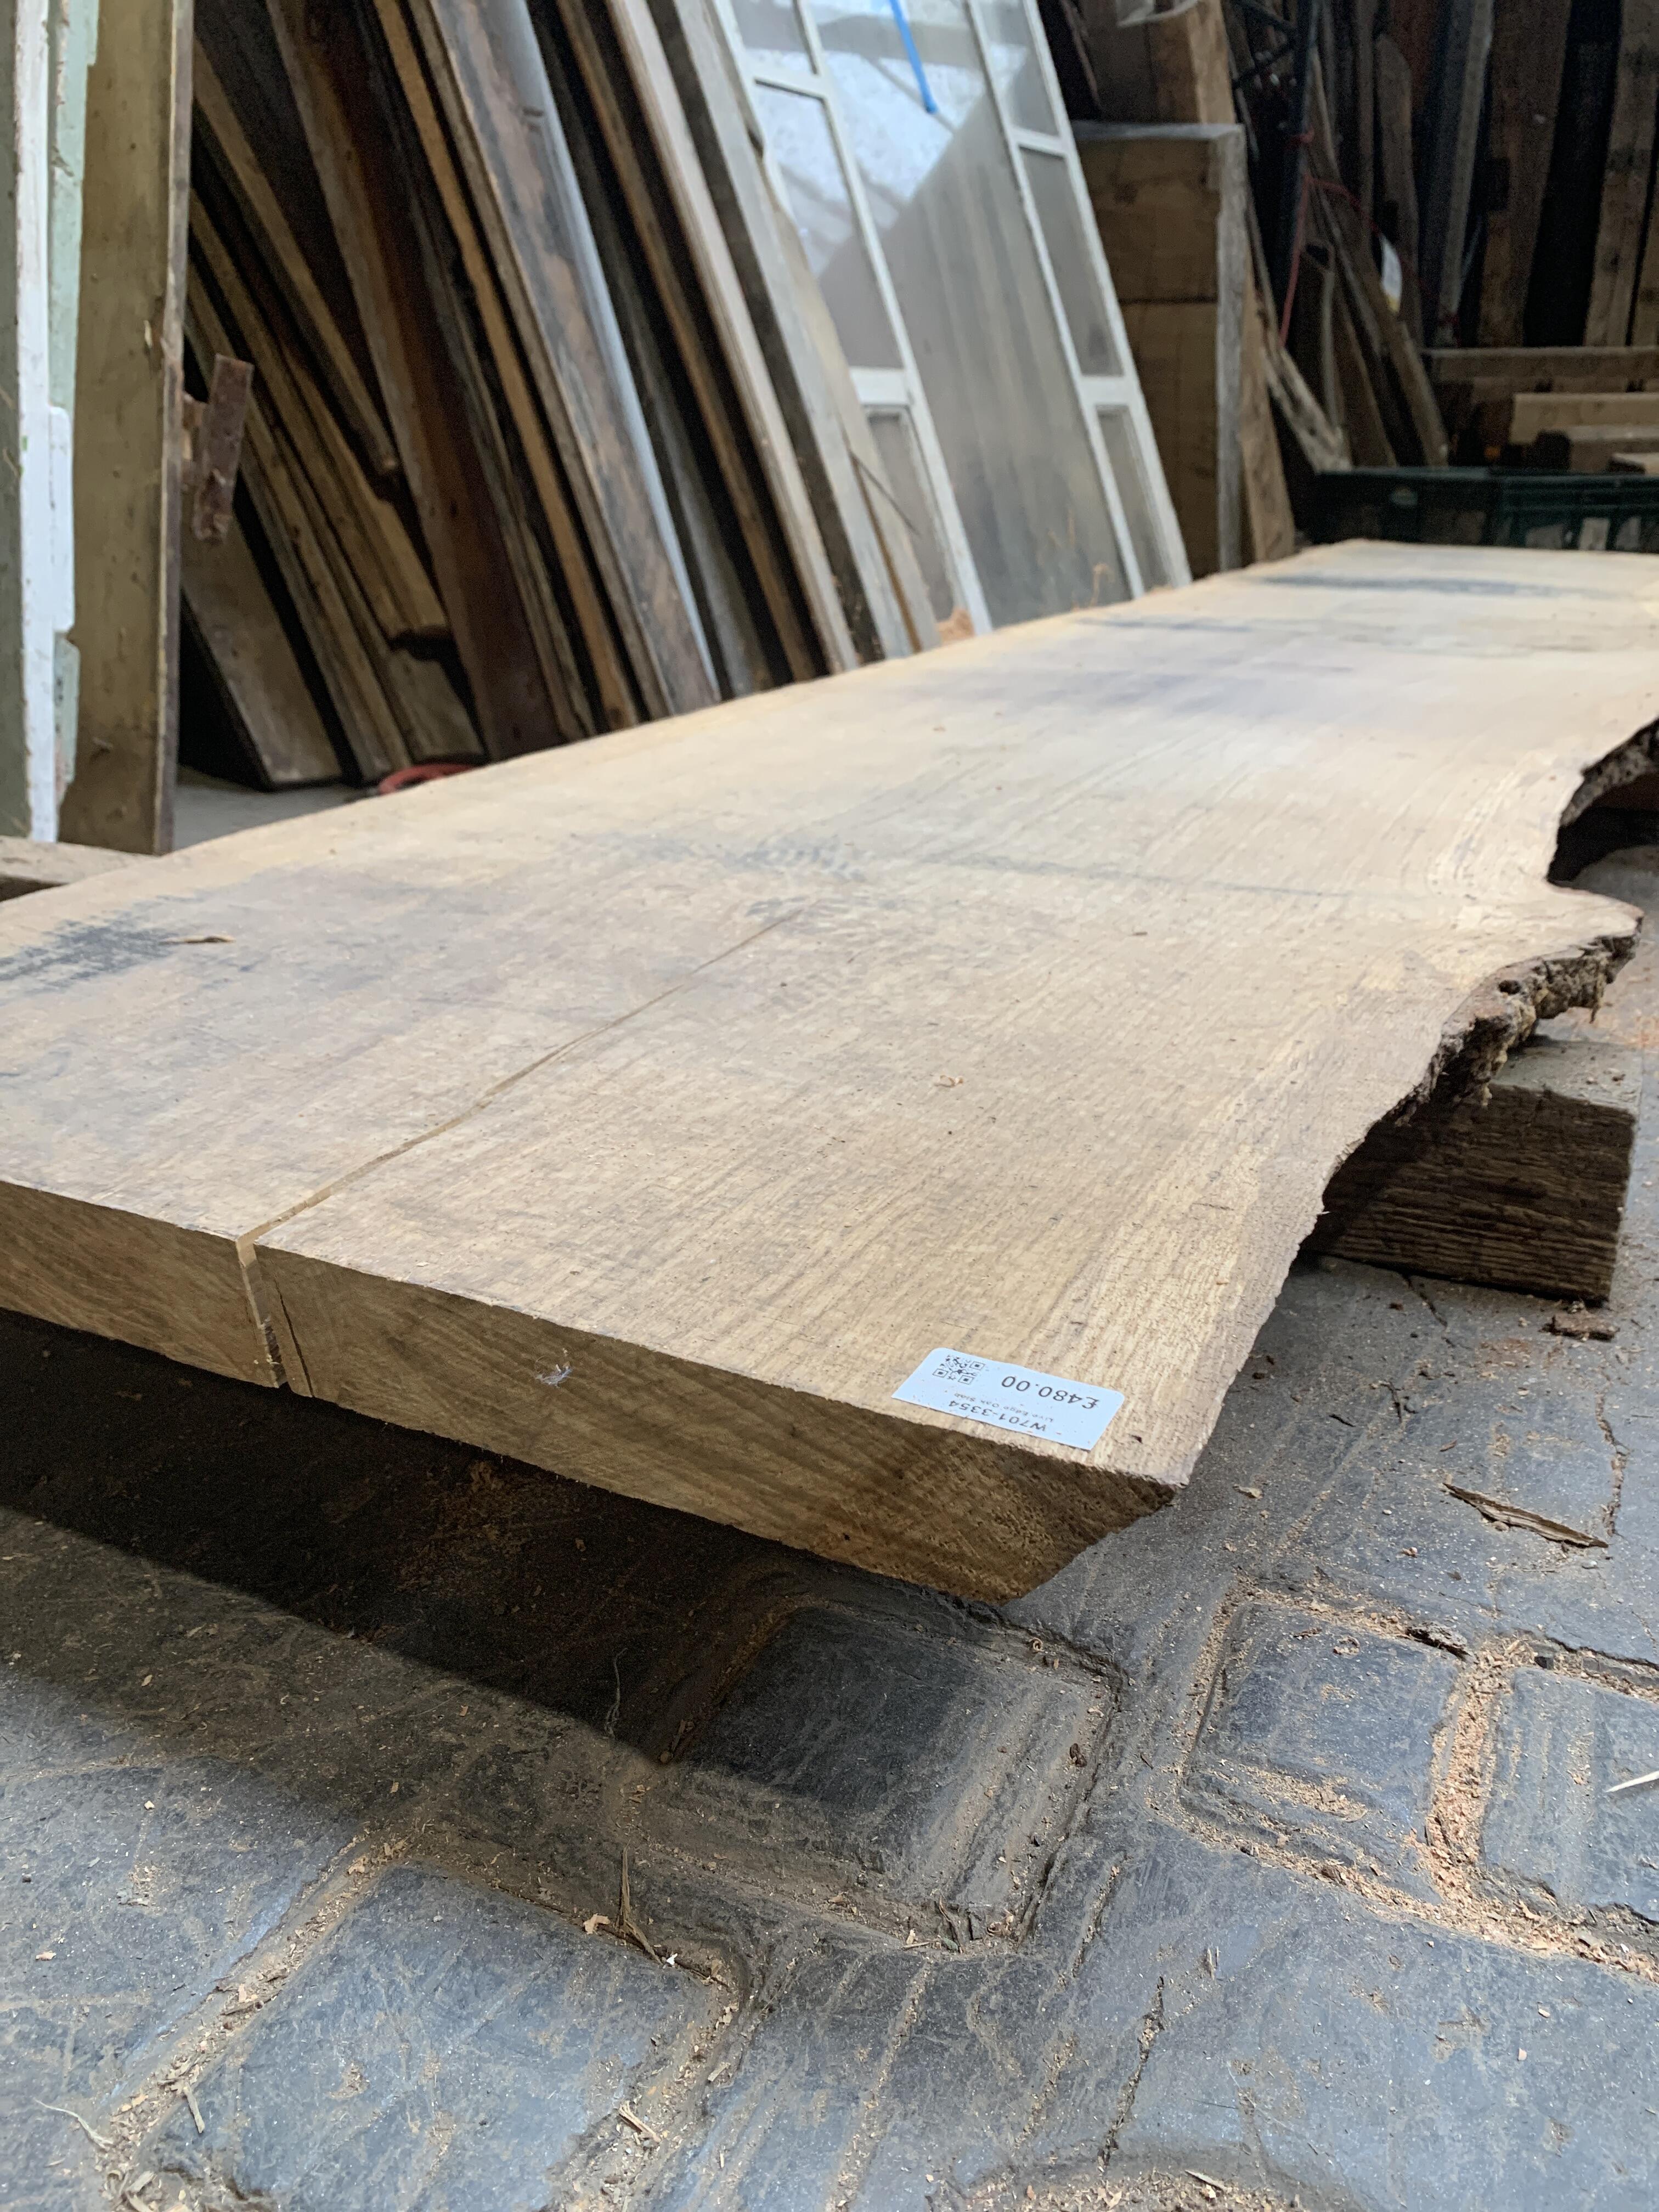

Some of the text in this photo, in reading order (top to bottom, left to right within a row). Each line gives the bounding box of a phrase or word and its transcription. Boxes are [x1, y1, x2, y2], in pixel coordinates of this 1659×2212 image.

[953, 1393, 1053, 1423] Live Edge Oak Slab
[1001, 1376, 1100, 1409] £480.00
[949, 1400, 1047, 1431] W701-3354
